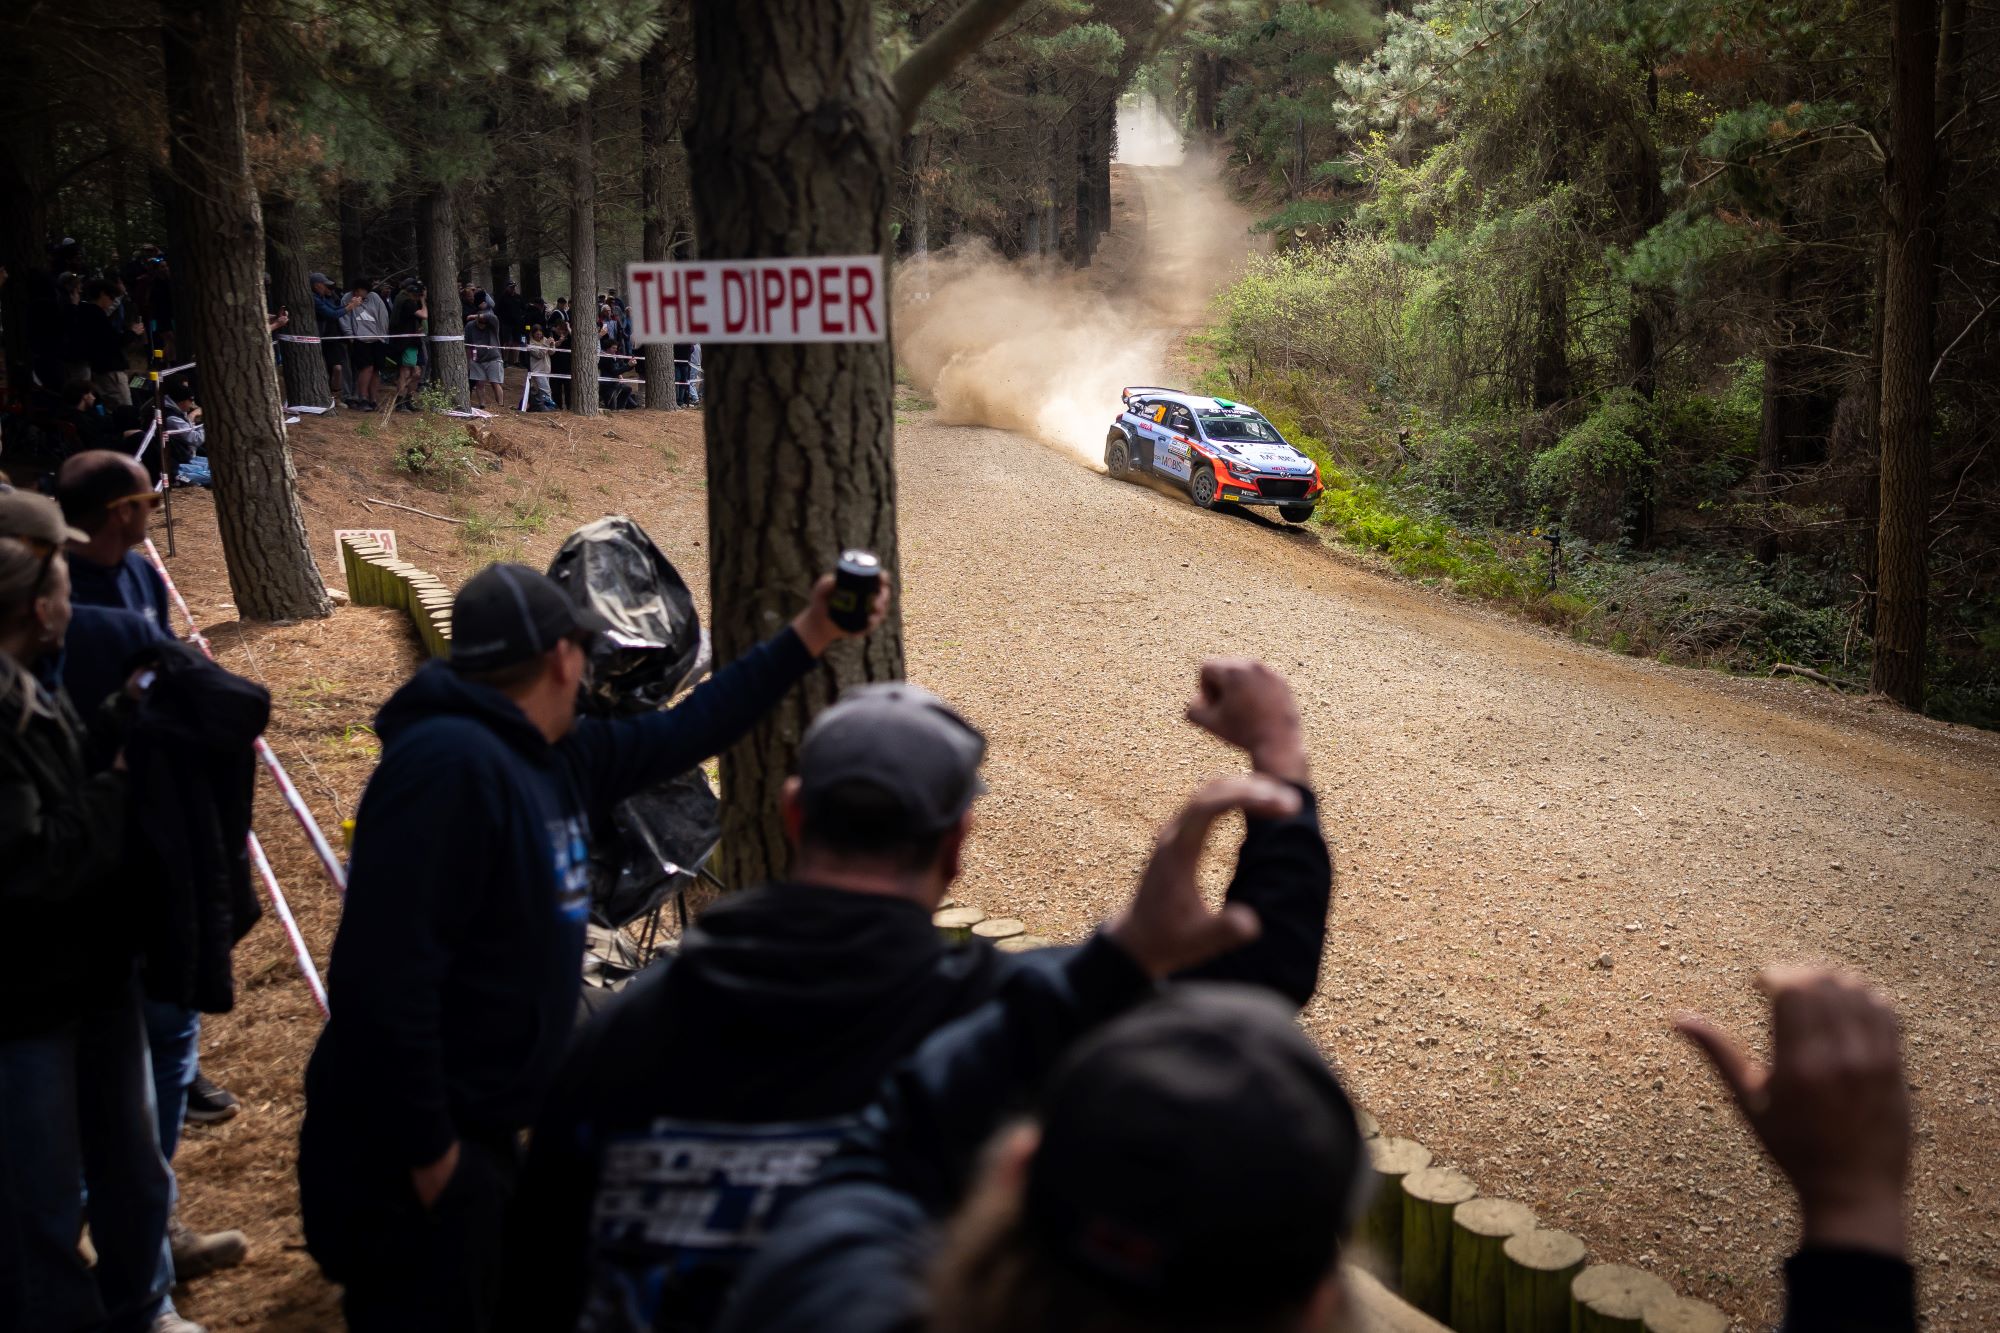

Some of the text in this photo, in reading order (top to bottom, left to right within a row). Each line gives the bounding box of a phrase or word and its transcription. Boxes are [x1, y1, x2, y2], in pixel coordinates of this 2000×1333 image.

[632, 267, 878, 335] THE DIPPER
[1161, 455, 1182, 472] MOBIS
[1259, 454, 1296, 463] MOBIS
